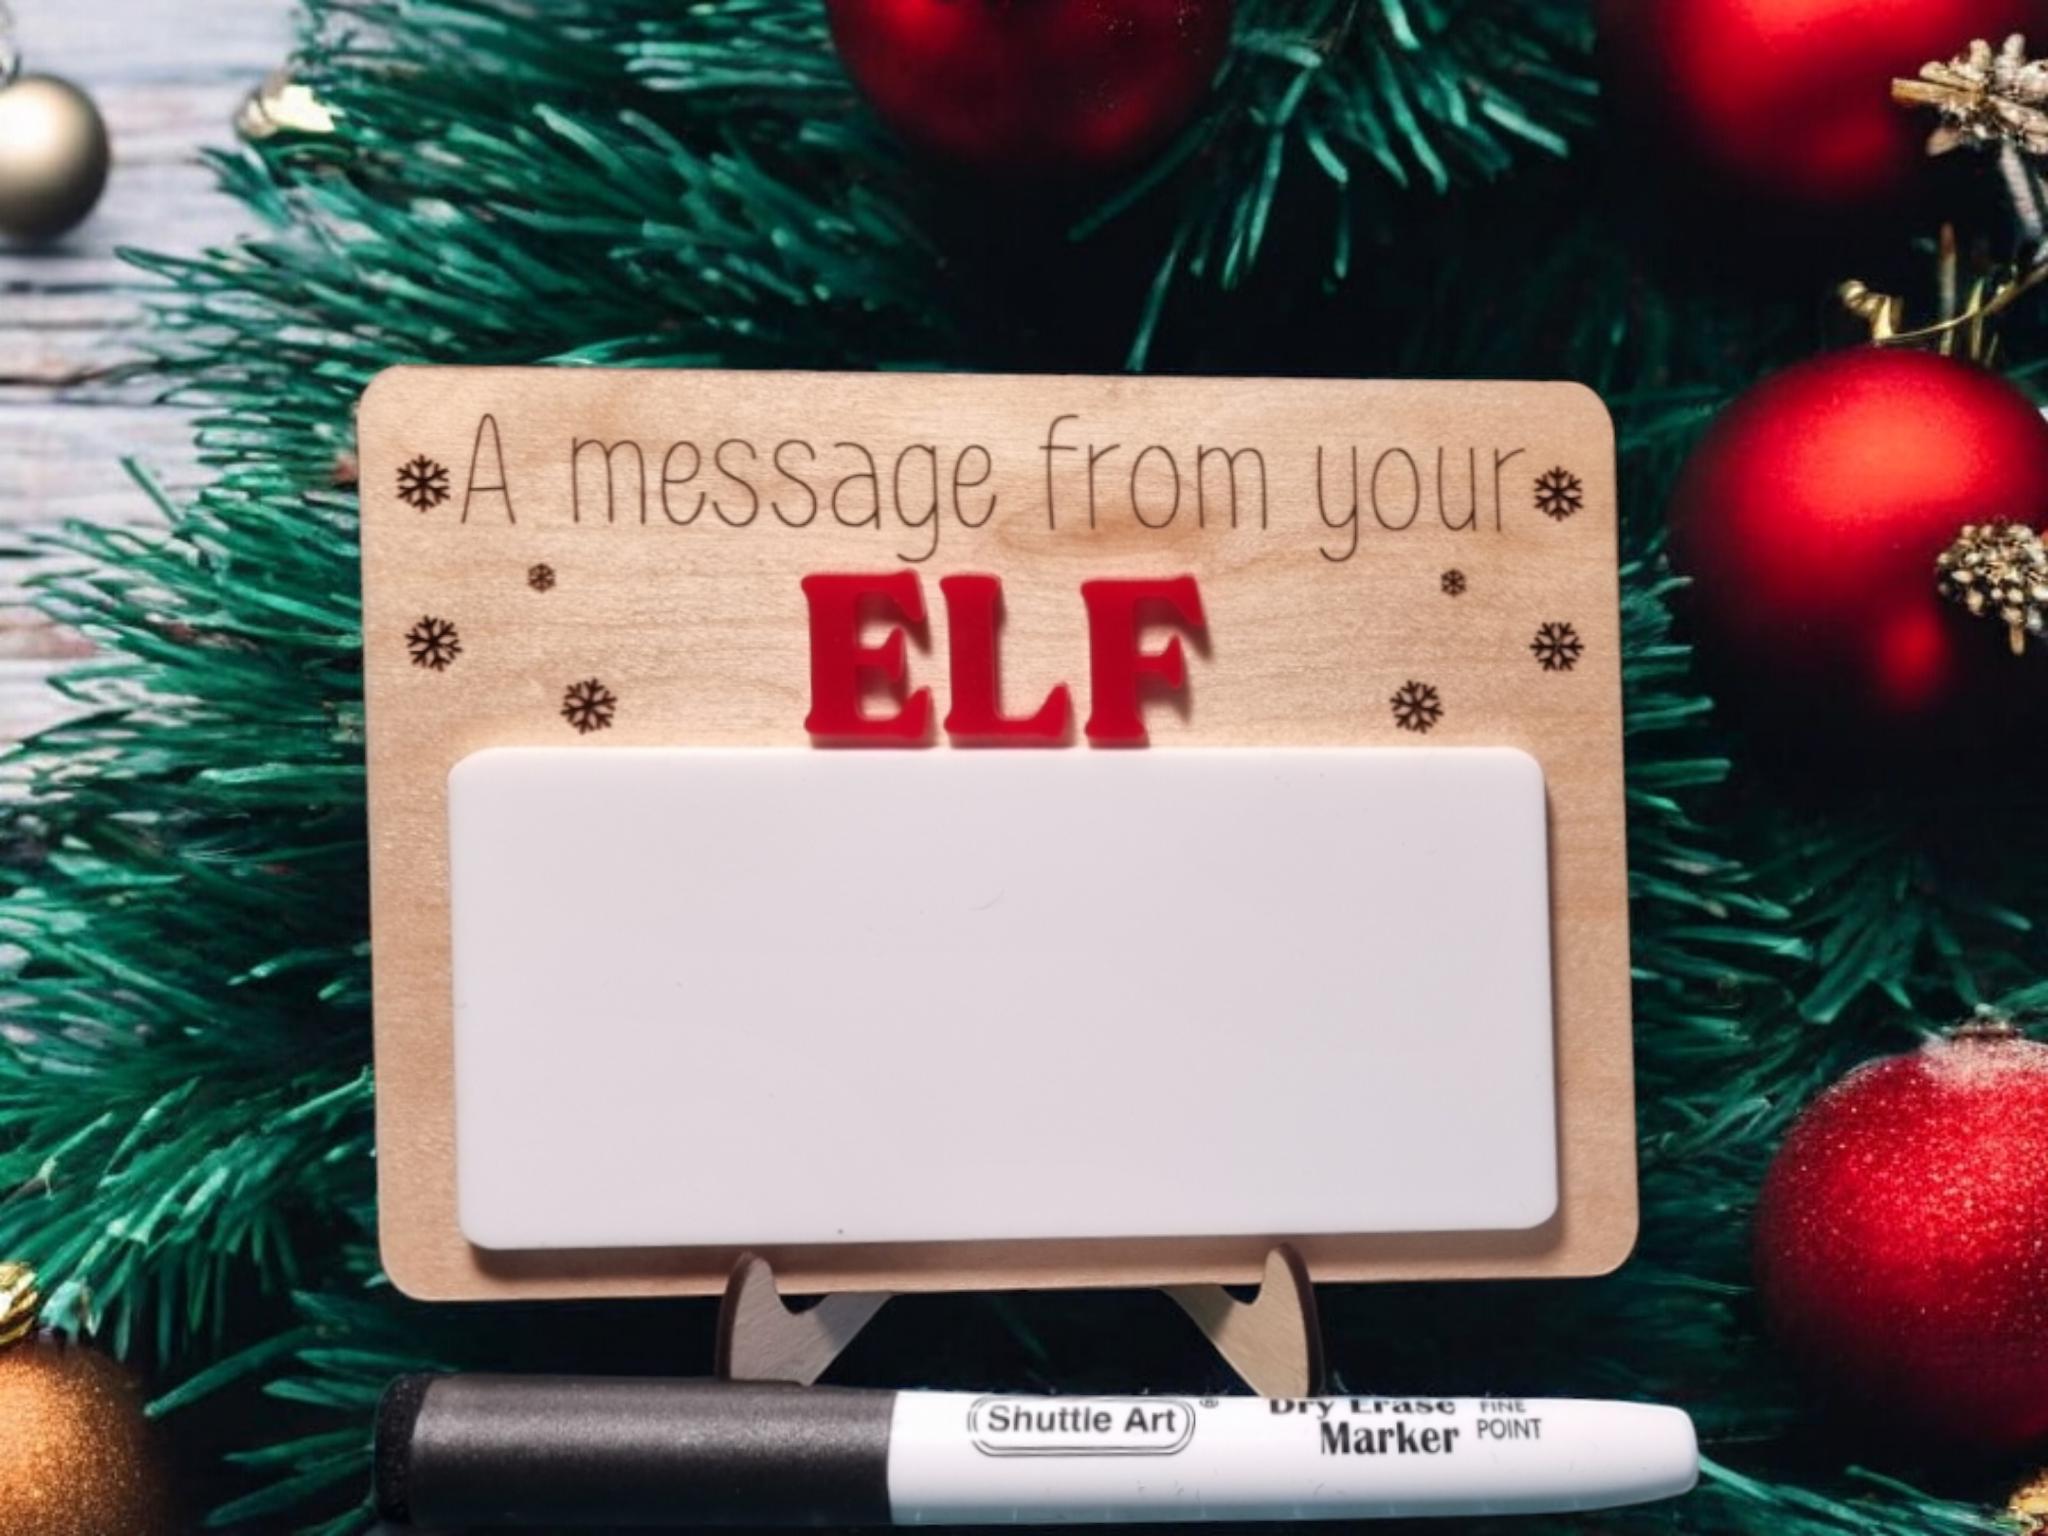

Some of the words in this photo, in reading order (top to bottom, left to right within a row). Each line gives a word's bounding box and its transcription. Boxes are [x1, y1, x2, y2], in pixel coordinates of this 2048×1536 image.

[461, 412, 517, 525] A
[570, 436, 998, 563] message
[1039, 413, 1268, 531] from
[1316, 444, 1527, 563] your
[800, 567, 1204, 749] ELF
[987, 1404, 1113, 1433] Shuttle
[1124, 1406, 1177, 1433] Art
[1269, 1398, 1335, 1420] Dry
[1479, 1398, 1527, 1414] FINE
[1319, 1420, 1460, 1455] Marker
[1476, 1417, 1542, 1440] POINT
